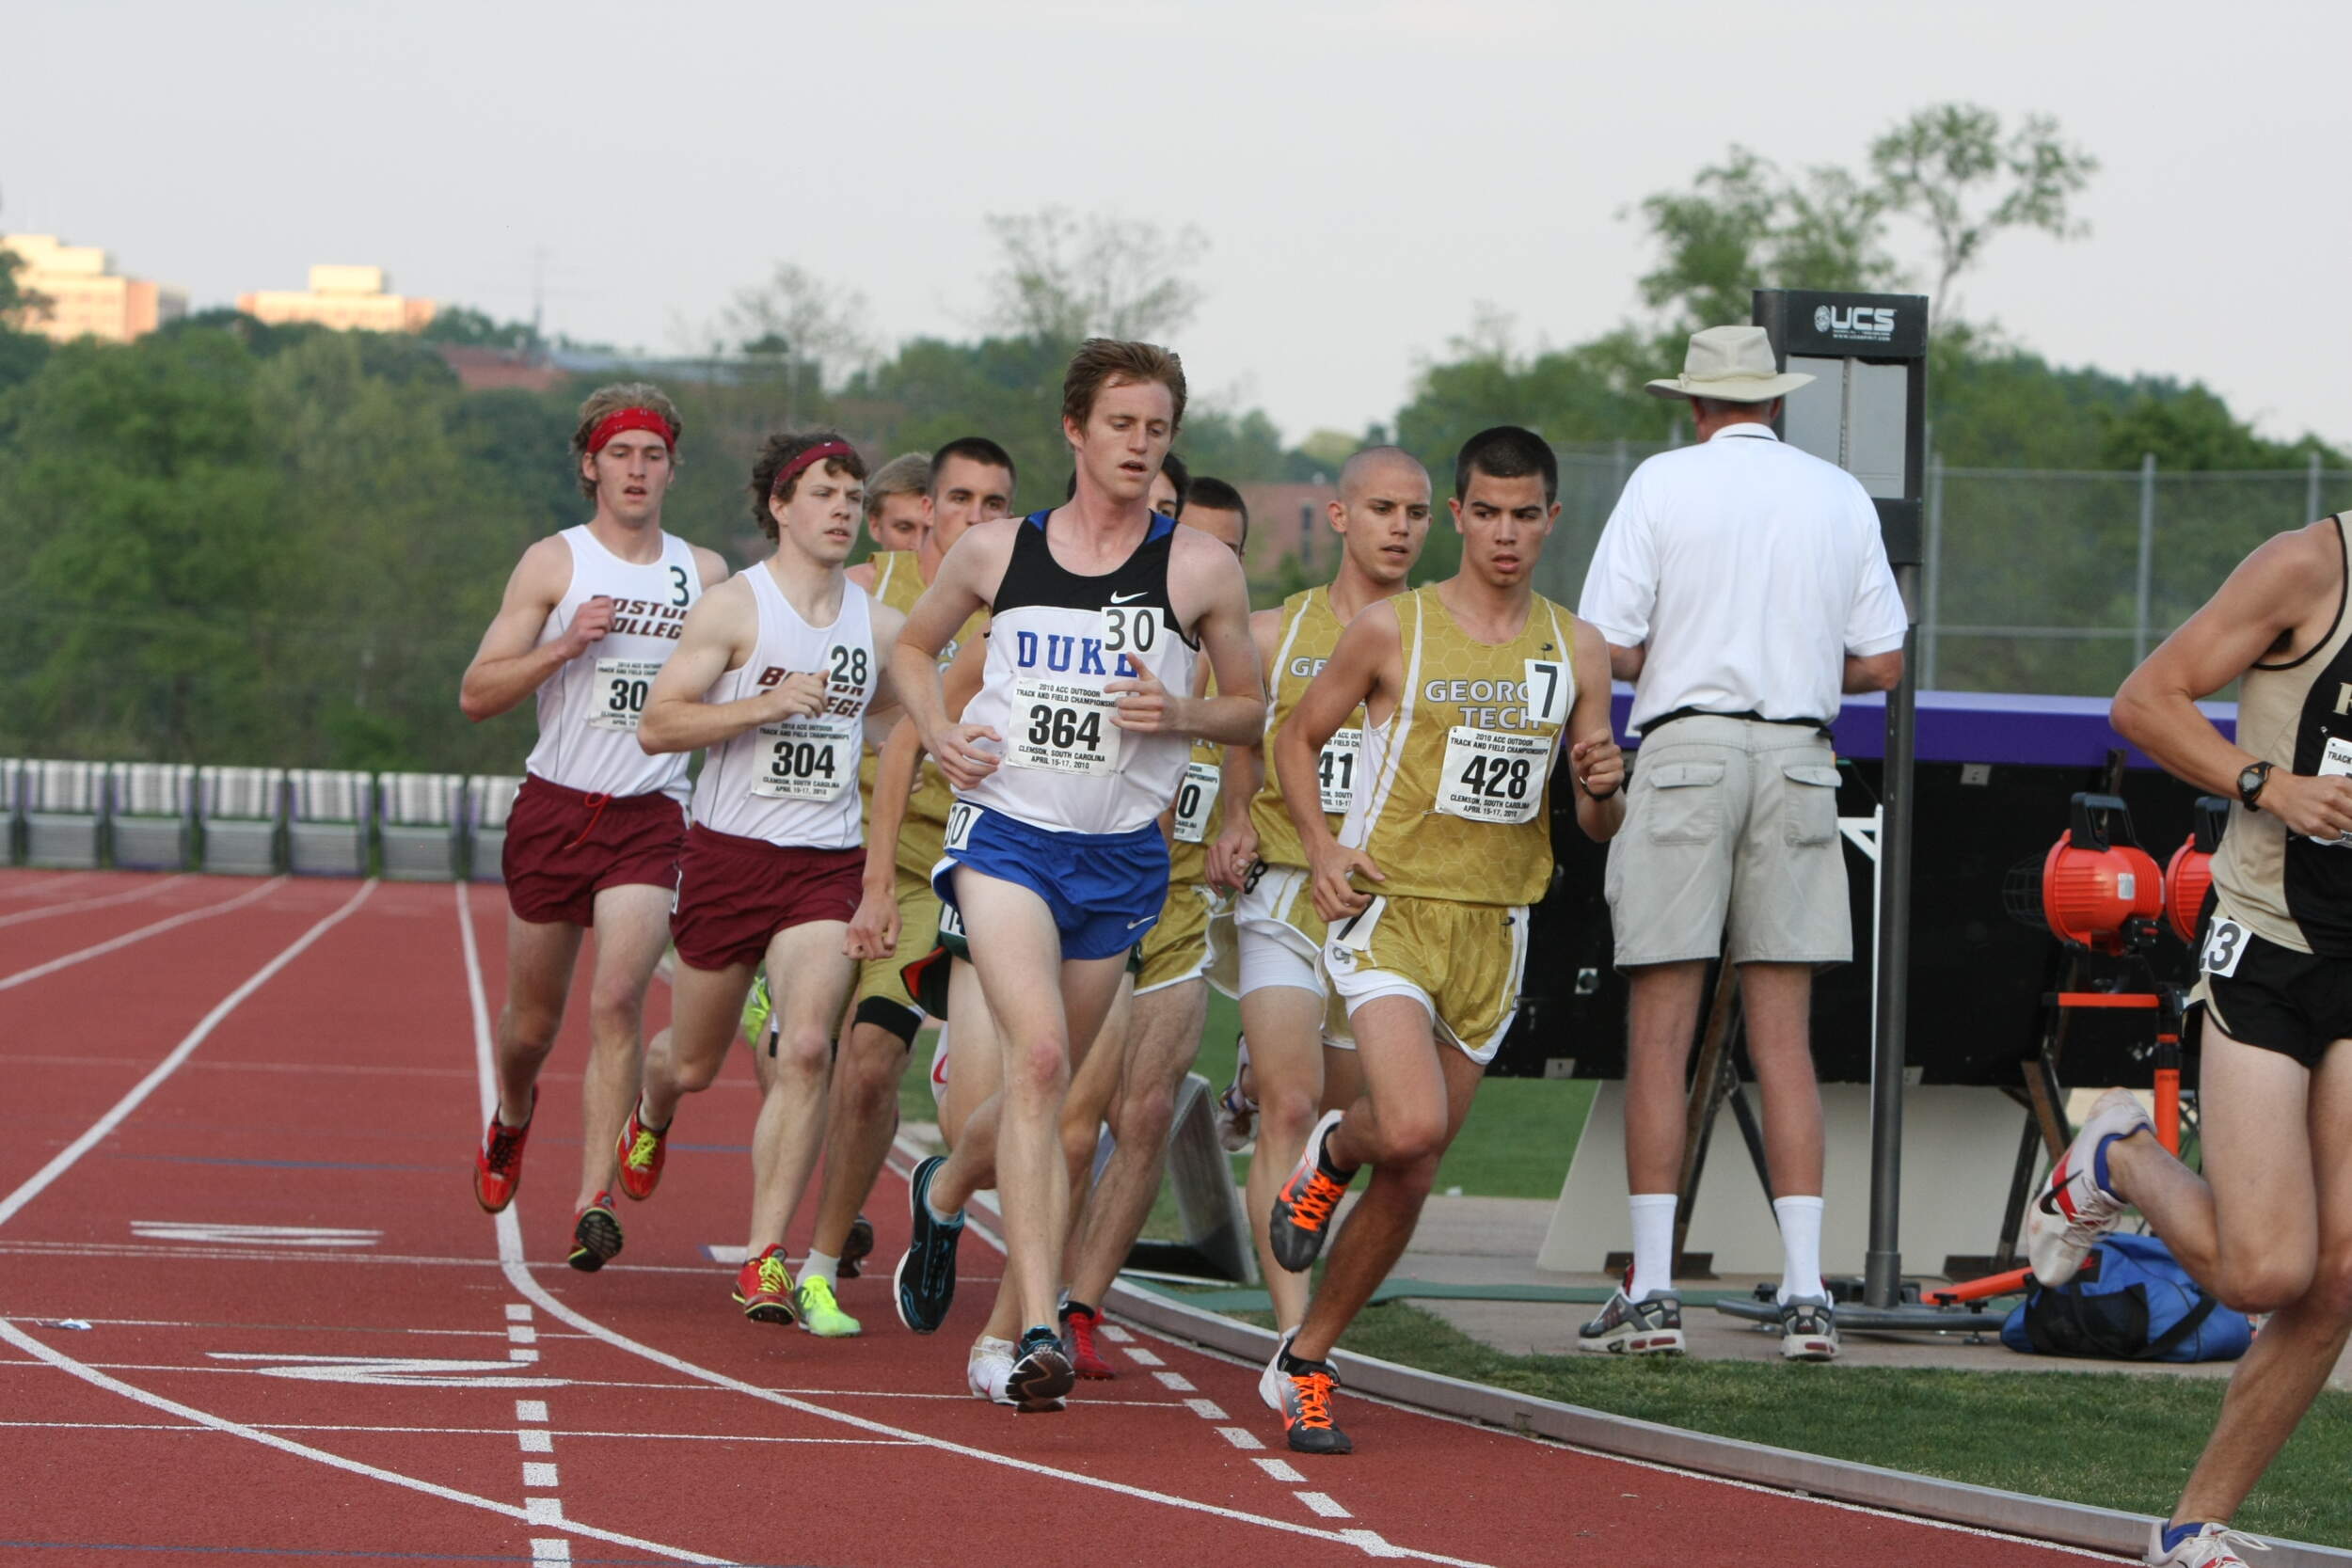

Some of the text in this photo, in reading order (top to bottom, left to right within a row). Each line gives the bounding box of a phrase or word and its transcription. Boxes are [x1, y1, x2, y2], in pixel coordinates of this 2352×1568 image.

[1831, 306, 1895, 332] UCS
[670, 565, 690, 608] 3
[612, 617, 682, 640] OLLEG
[1104, 609, 1155, 652] 30
[830, 645, 867, 686] 28
[609, 678, 648, 712] 30
[1016, 689, 1036, 697] TRACK
[1037, 691, 1049, 700] AND
[1051, 693, 1069, 702] FIELD
[1071, 688, 1101, 697] OUTDOOR
[1534, 663, 1558, 719] 7
[1028, 705, 1101, 752] 364
[1051, 750, 1073, 758] SOUTH
[1073, 752, 1105, 762] CAROLINA
[1451, 737, 1471, 746] TRACK
[1472, 741, 1486, 750] AND
[1488, 744, 1504, 752] FIELD
[771, 741, 835, 779] 304
[1030, 755, 1049, 765] APRIL
[1319, 752, 1353, 789] 41
[1460, 754, 1531, 800] 428
[1463, 805, 1482, 814] APRIL
[1483, 799, 1503, 807] SOUTH
